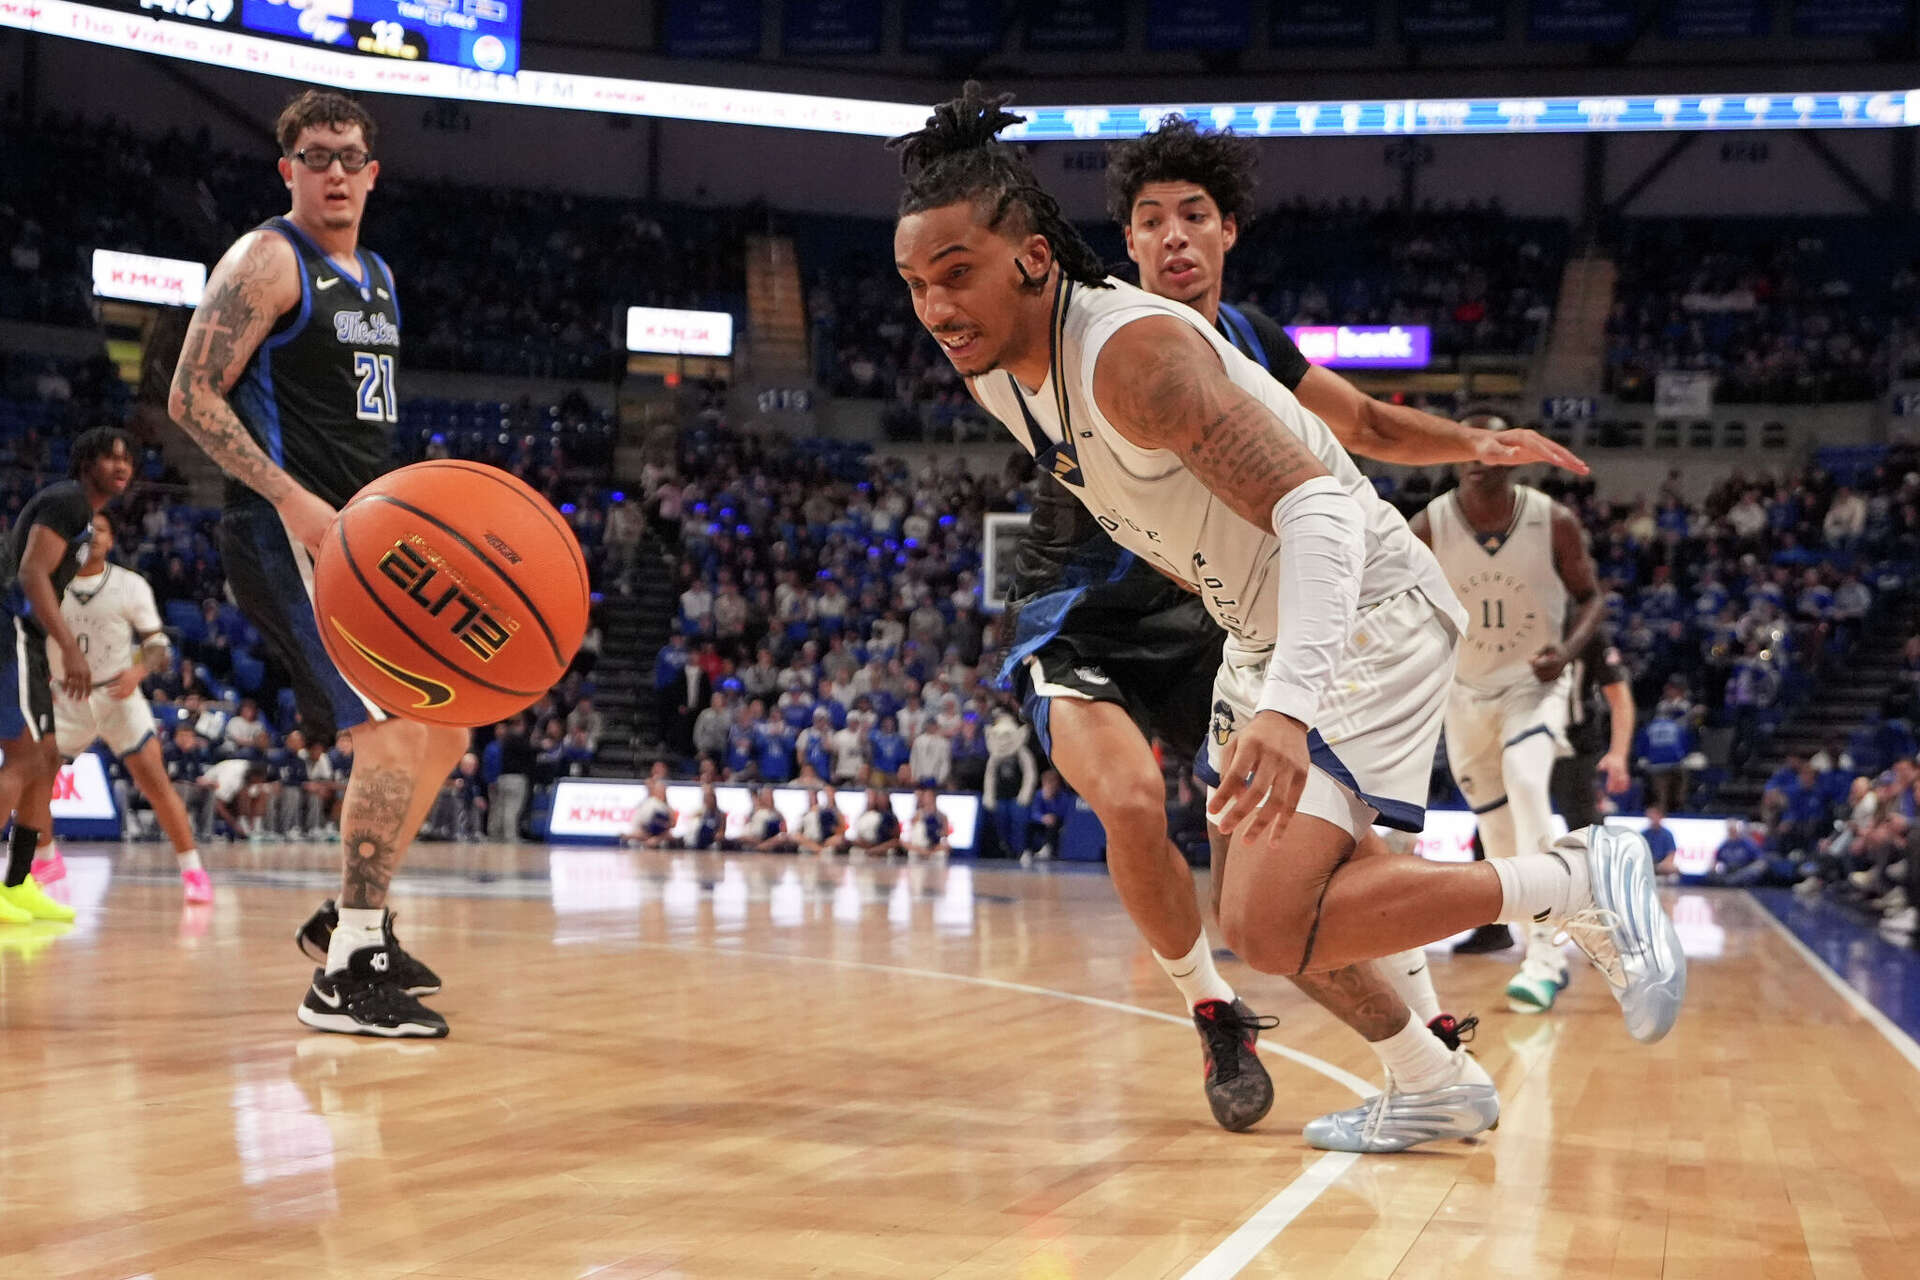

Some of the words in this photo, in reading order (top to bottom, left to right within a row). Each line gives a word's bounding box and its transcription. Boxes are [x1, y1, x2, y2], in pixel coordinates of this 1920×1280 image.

[354, 351, 399, 424] 21
[377, 539, 512, 663] ELITE
[1482, 598, 1506, 629] 11
